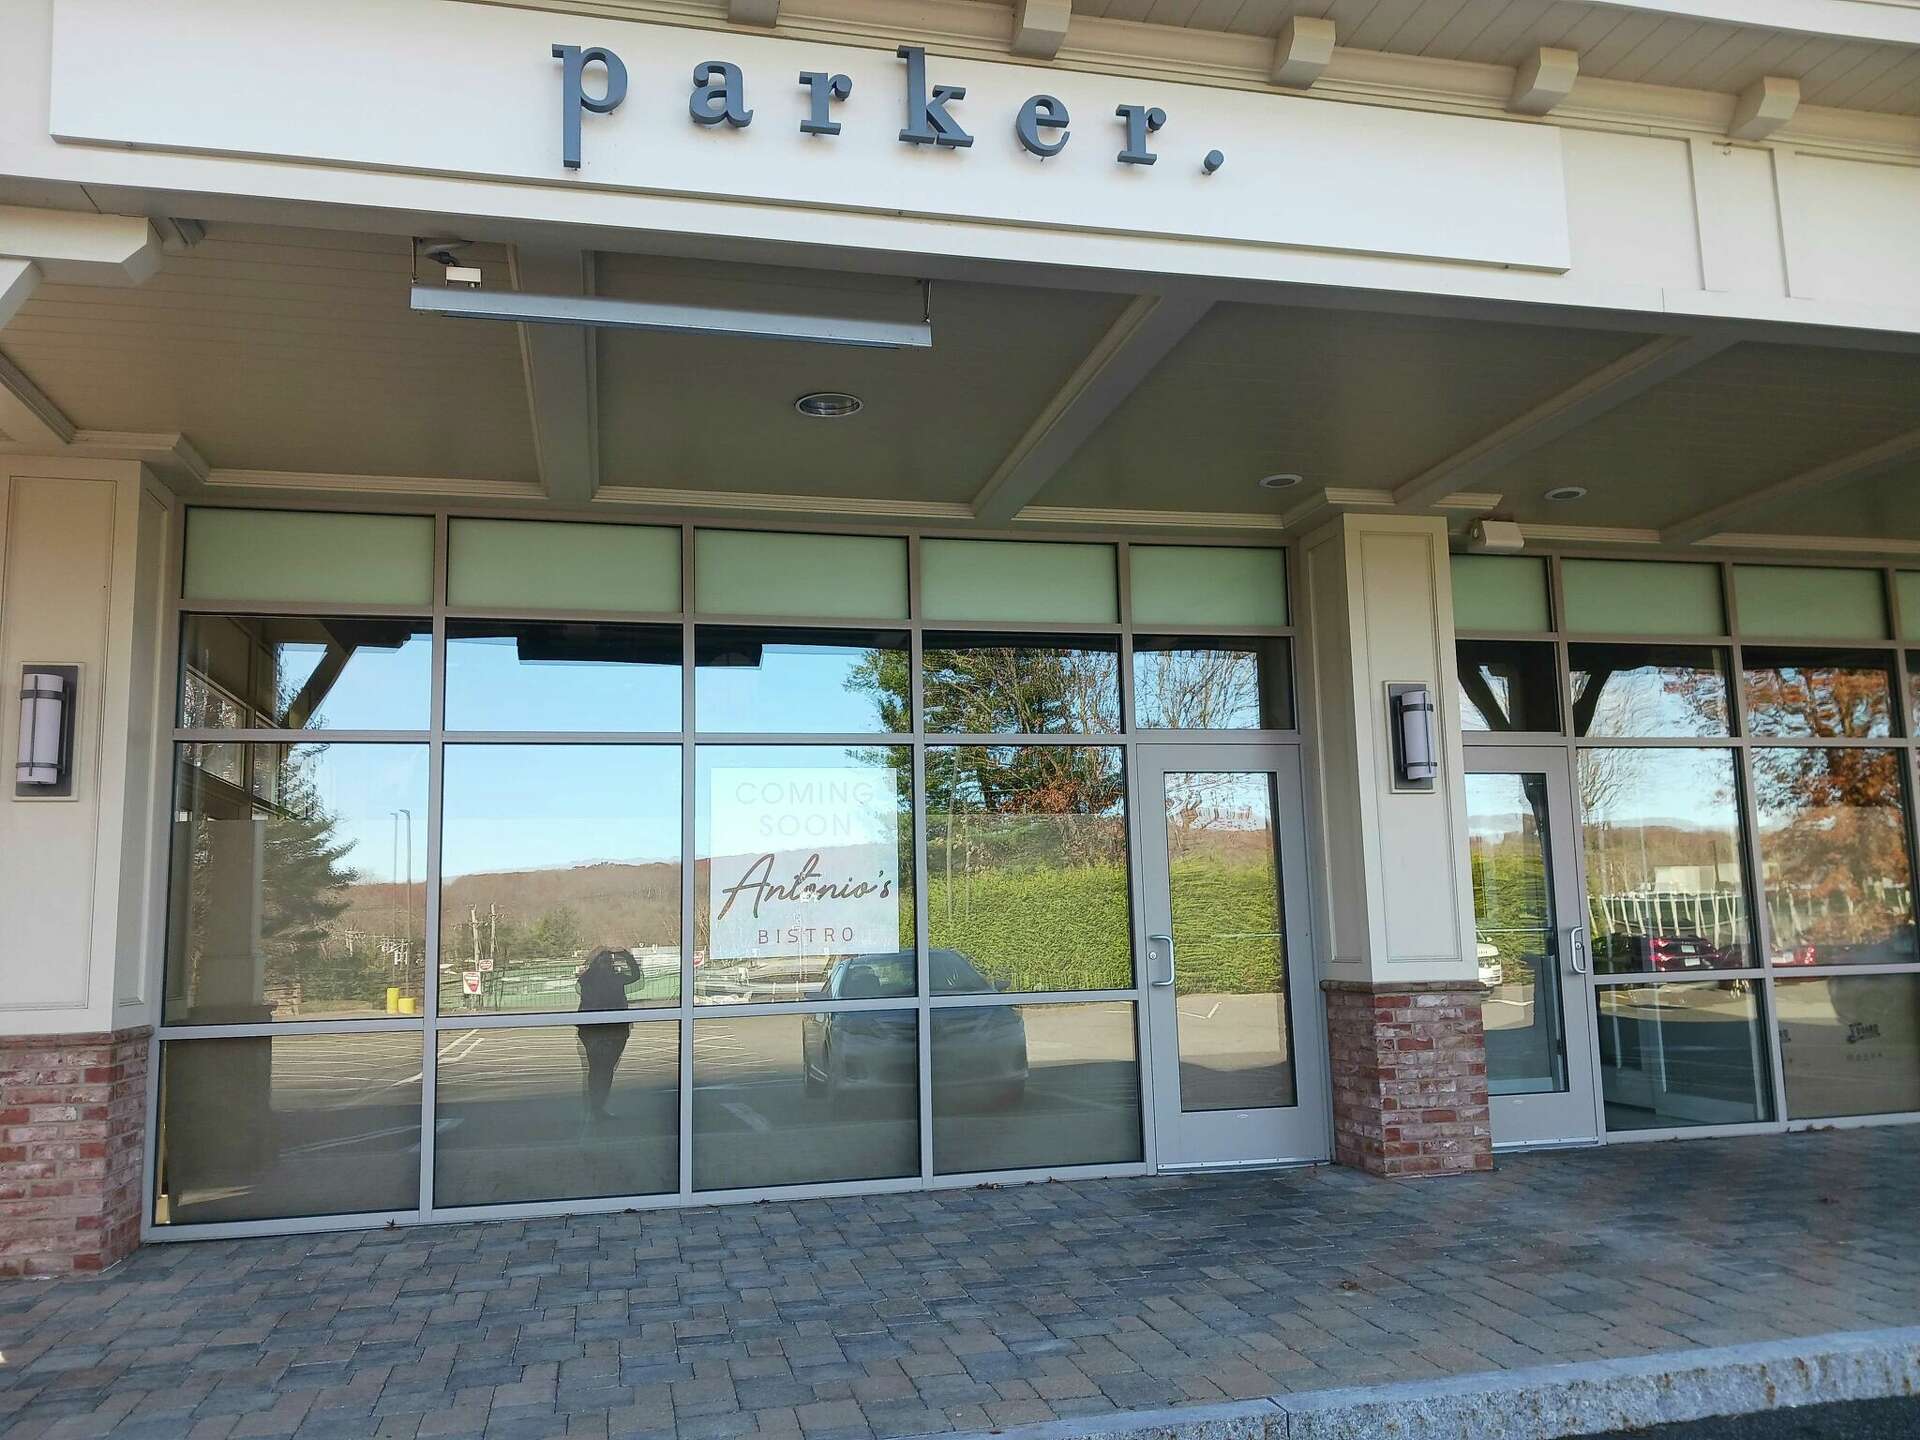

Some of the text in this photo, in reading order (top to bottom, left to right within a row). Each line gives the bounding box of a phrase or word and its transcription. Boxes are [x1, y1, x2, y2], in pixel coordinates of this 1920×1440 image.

[551, 43, 1224, 171] parker.
[736, 782, 873, 804] COMING
[759, 814, 851, 836] SOON
[717, 853, 892, 921] Antonio's
[757, 927, 854, 945] BISTRO
